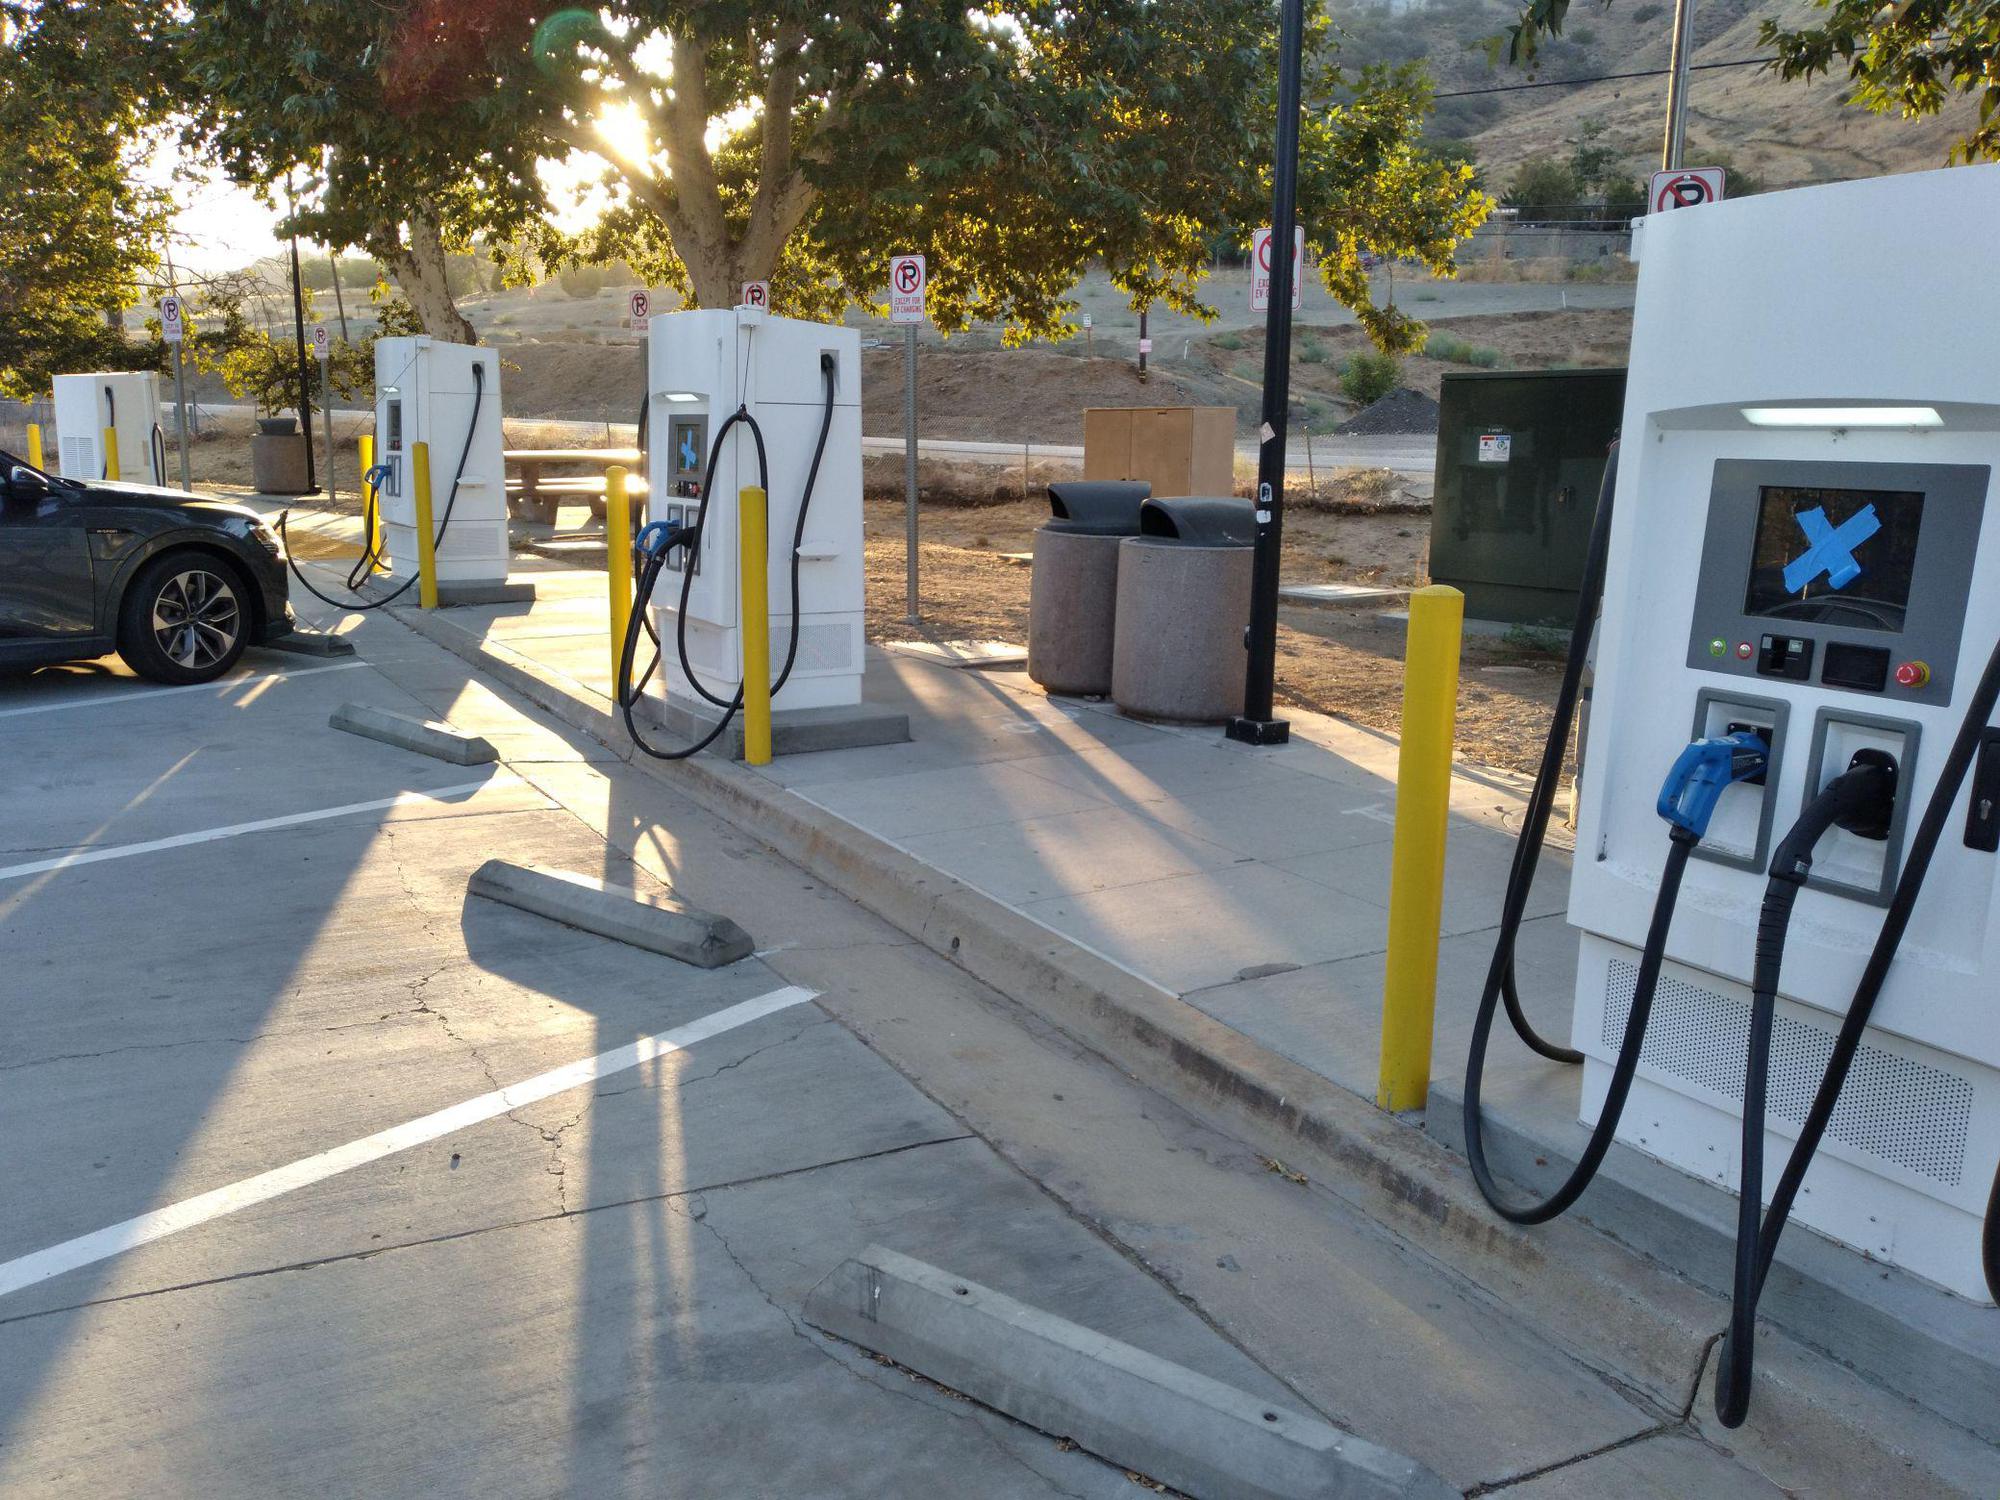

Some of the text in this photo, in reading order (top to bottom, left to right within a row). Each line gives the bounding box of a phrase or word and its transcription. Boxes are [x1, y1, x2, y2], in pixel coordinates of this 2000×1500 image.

[902, 264, 917, 289] P
[1255, 289, 1263, 298] EV
[894, 305, 900, 313] EV
